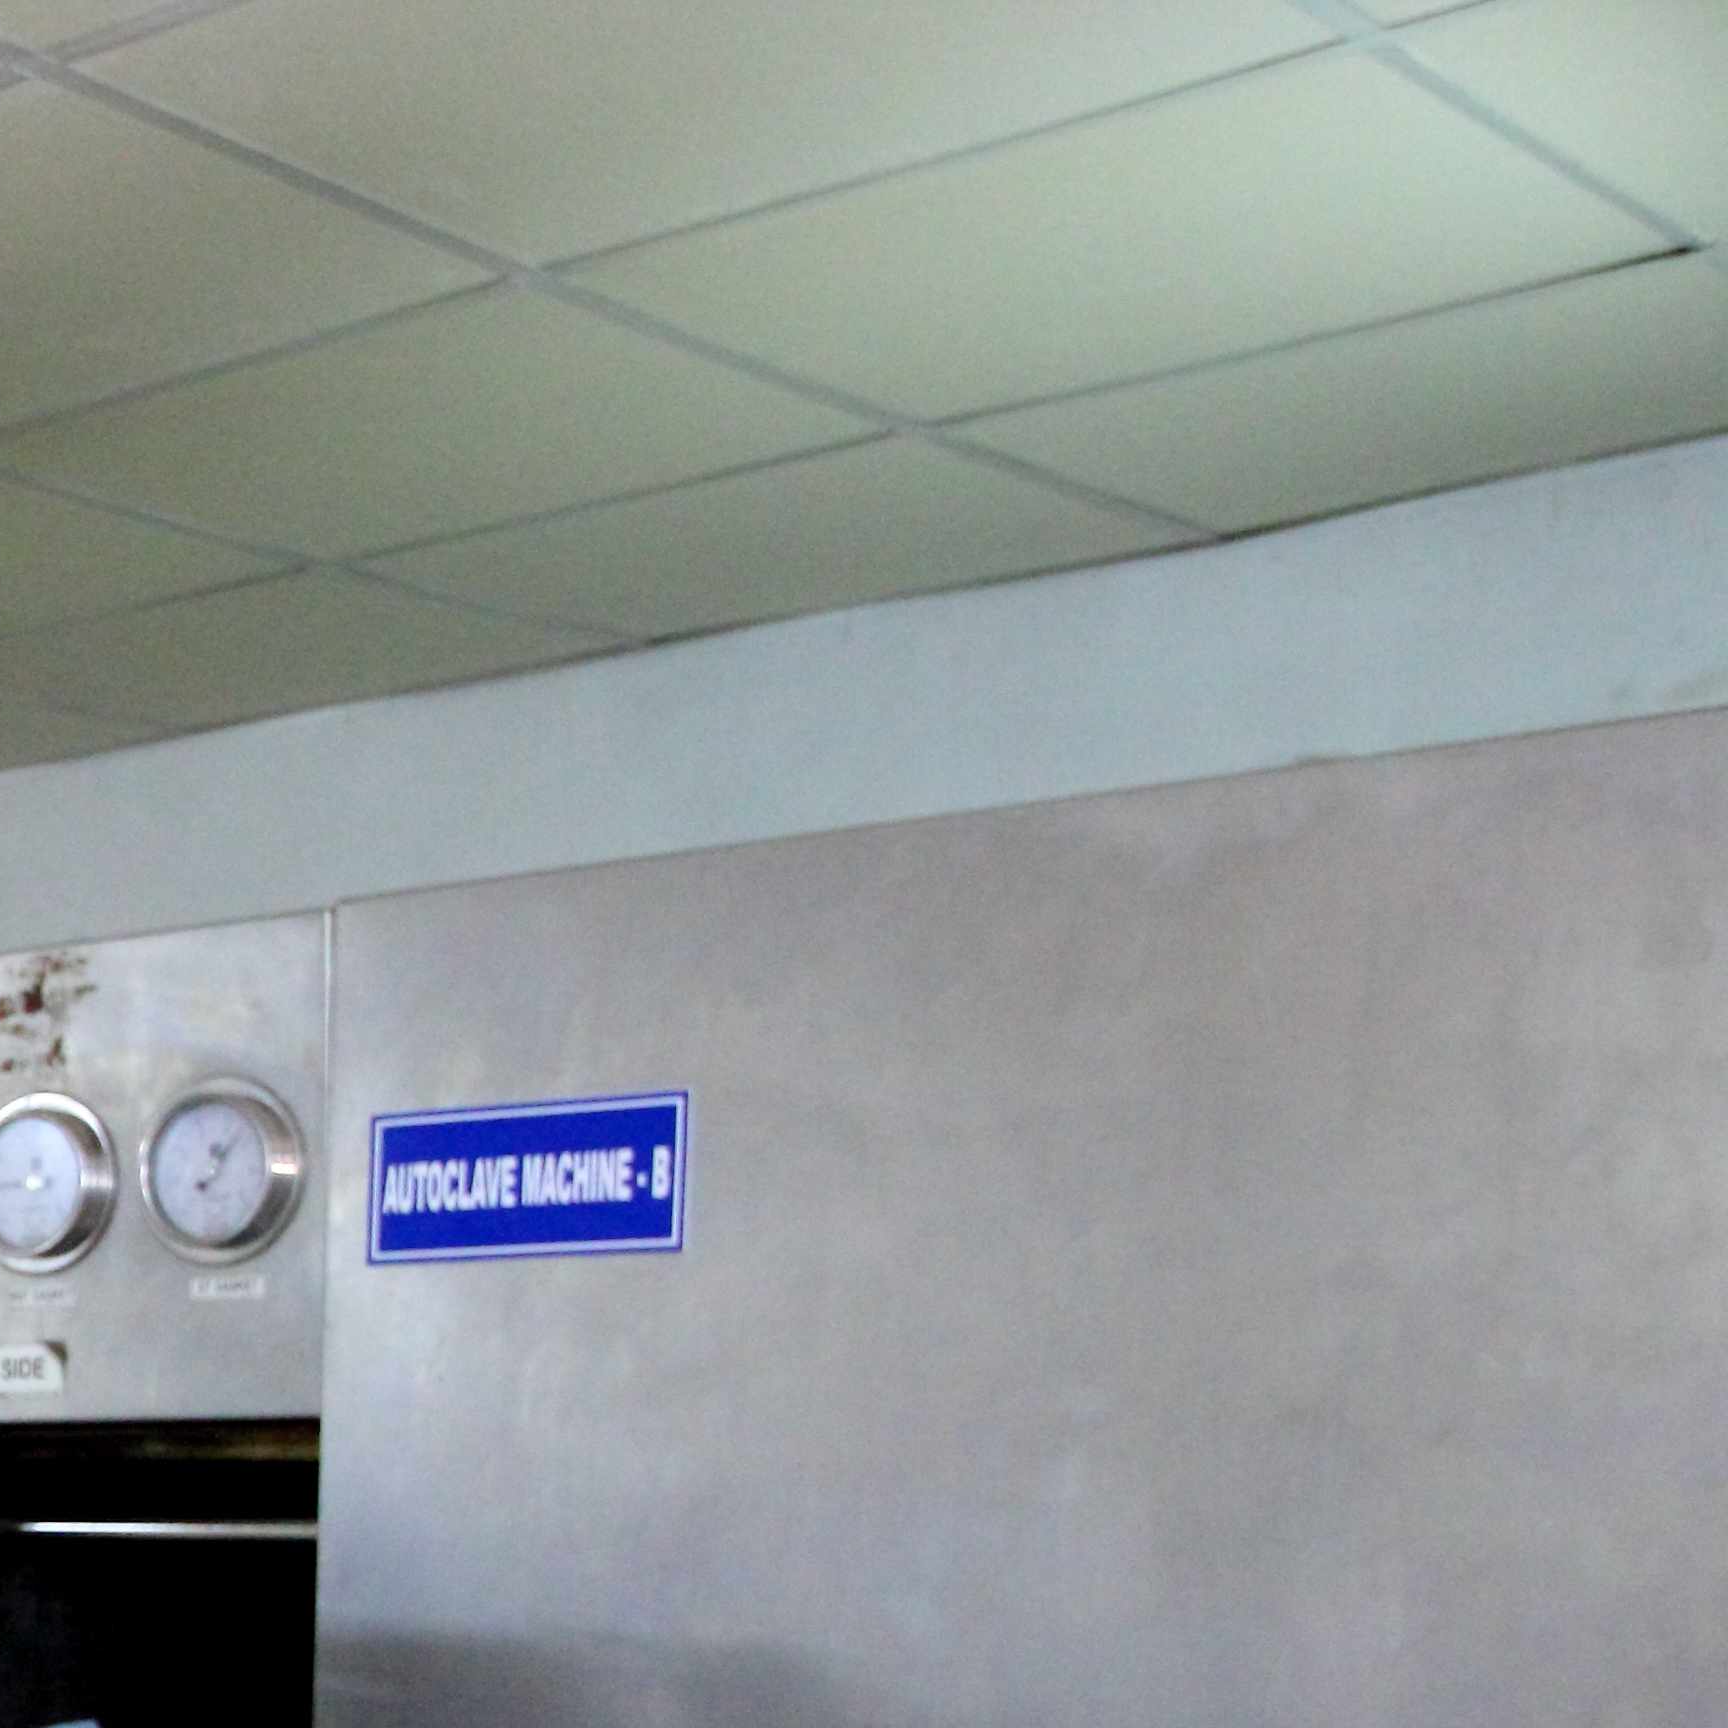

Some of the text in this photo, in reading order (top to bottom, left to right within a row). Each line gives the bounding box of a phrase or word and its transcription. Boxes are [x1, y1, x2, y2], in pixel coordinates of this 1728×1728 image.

[383, 1156, 518, 1214] AUTOCLAVE
[521, 1147, 633, 1204] MACHINE
[1, 1356, 45, 1380] SIDE
